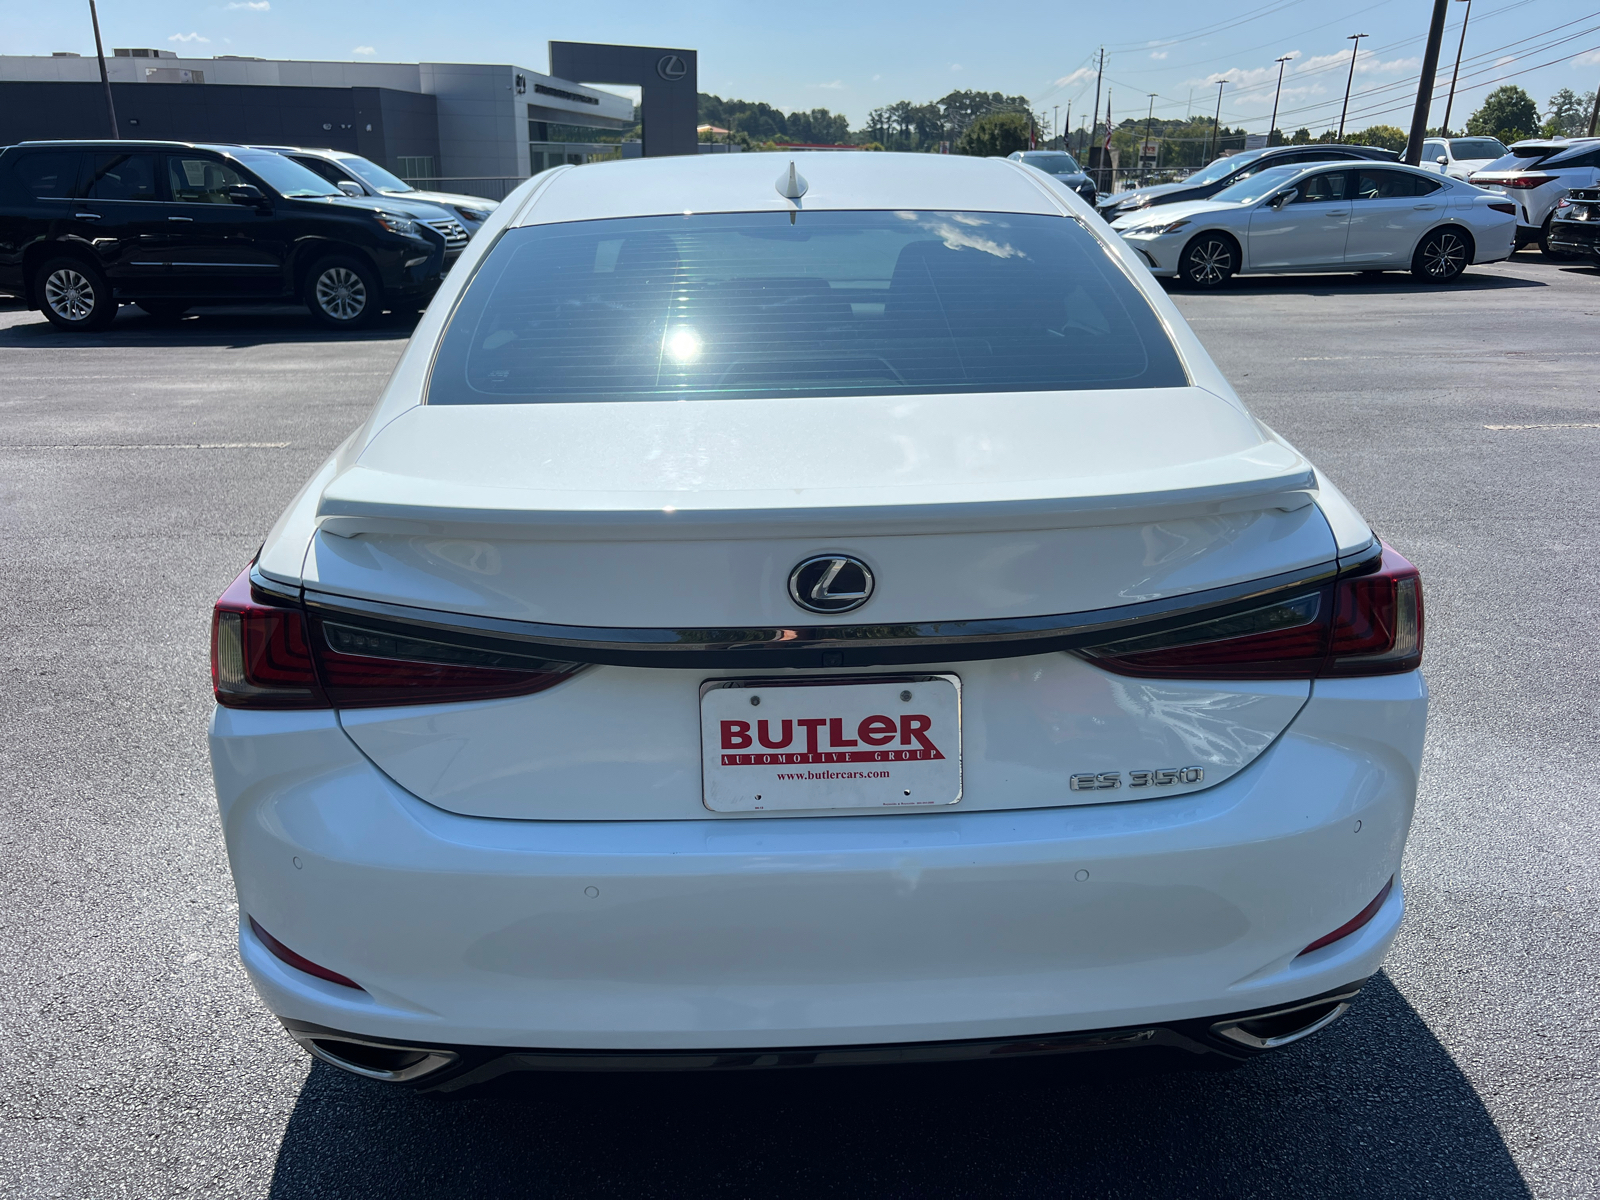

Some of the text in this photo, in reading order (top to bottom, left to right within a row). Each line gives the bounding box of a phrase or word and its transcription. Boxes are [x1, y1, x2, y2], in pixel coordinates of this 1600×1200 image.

[722, 750, 938, 765] AUTOMOTIVE GROUP
[777, 769, 890, 781] www.butlercars.com
[1070, 766, 1204, 791] ES 350
